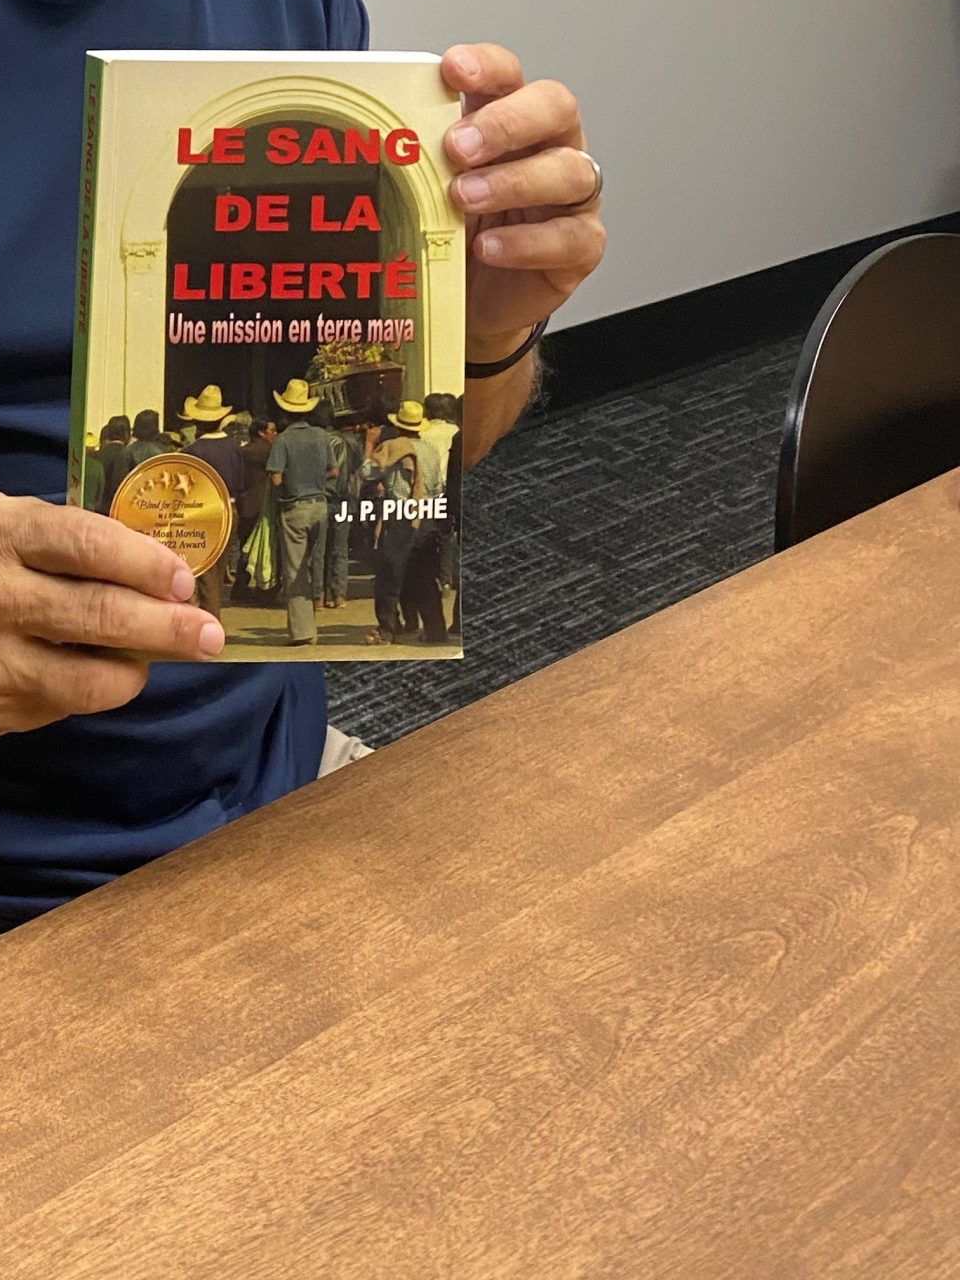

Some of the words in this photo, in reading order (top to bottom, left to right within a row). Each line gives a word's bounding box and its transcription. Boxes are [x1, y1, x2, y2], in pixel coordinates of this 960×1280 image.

[87, 83, 97, 108] LE
[84, 114, 96, 171] SANG
[177, 128, 245, 165] LE
[265, 127, 421, 166] SANG
[82, 179, 93, 206] DE
[81, 213, 91, 241] LA
[214, 194, 290, 232] DE
[310, 195, 382, 232] LA
[173, 252, 418, 301] LIBERTÉ
[168, 312, 206, 345] Une
[211, 312, 283, 344] mission
[288, 319, 311, 343] en
[316, 313, 362, 342] terre
[367, 317, 415, 351] maya
[137, 500, 161, 509] Blood
[159, 502, 171, 511] for
[172, 499, 204, 511] Freedom
[334, 500, 354, 523] J.
[360, 500, 377, 522] P.
[382, 492, 448, 521] PICHÉ
[152, 529, 173, 538] Most
[175, 529, 206, 539] Moving
[178, 540, 206, 549] Award
